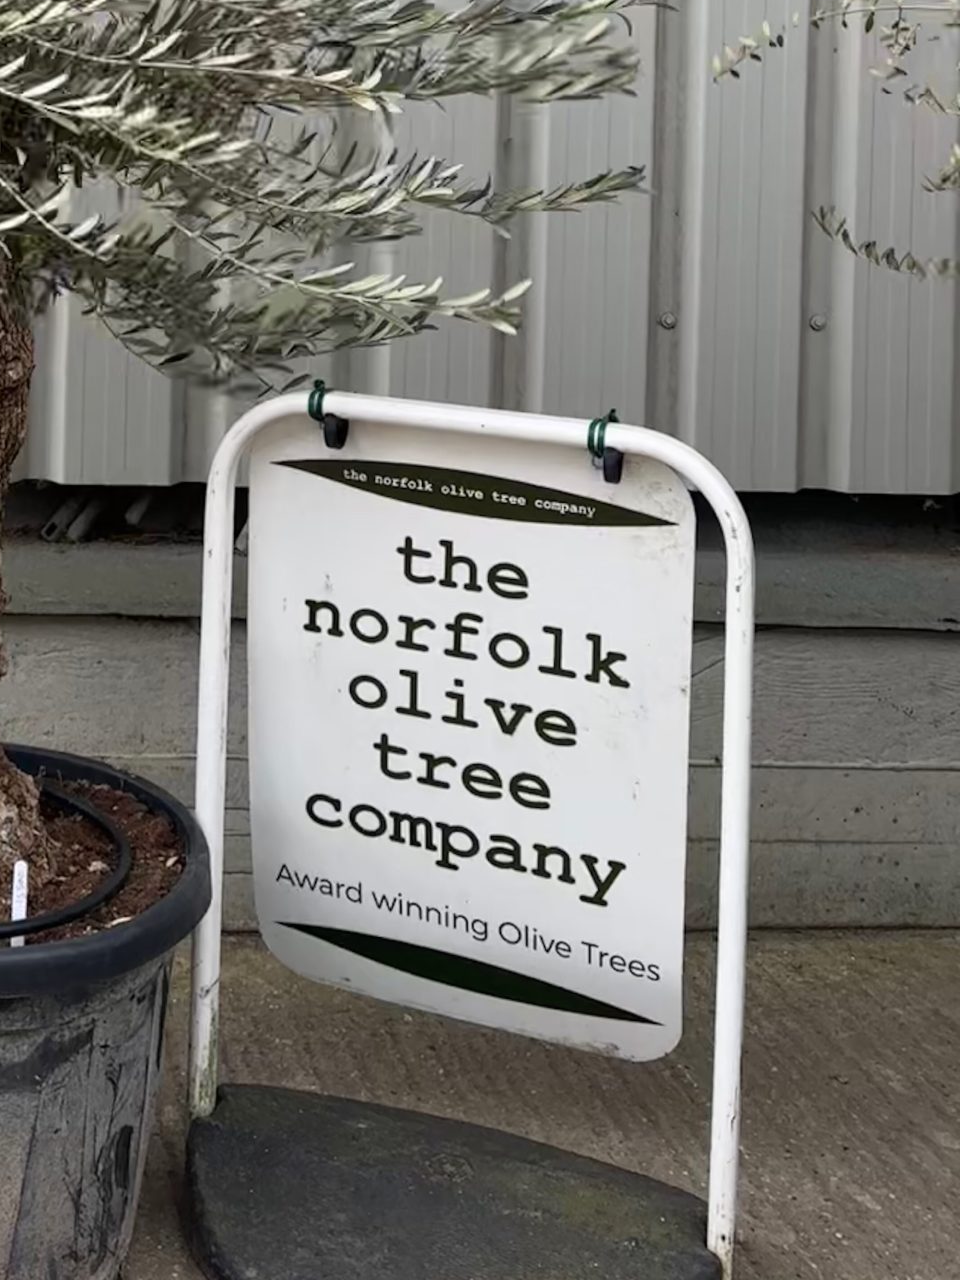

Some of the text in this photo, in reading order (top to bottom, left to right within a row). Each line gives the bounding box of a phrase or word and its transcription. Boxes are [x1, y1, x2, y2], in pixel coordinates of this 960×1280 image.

[343, 468, 596, 518] the norfolk olive tree company
[396, 535, 529, 600] the
[303, 599, 631, 689] norfolk
[348, 669, 577, 747] olive
[373, 733, 551, 810] tree
[305, 793, 627, 907] company
[275, 862, 661, 983] Award winning Olive Trees
